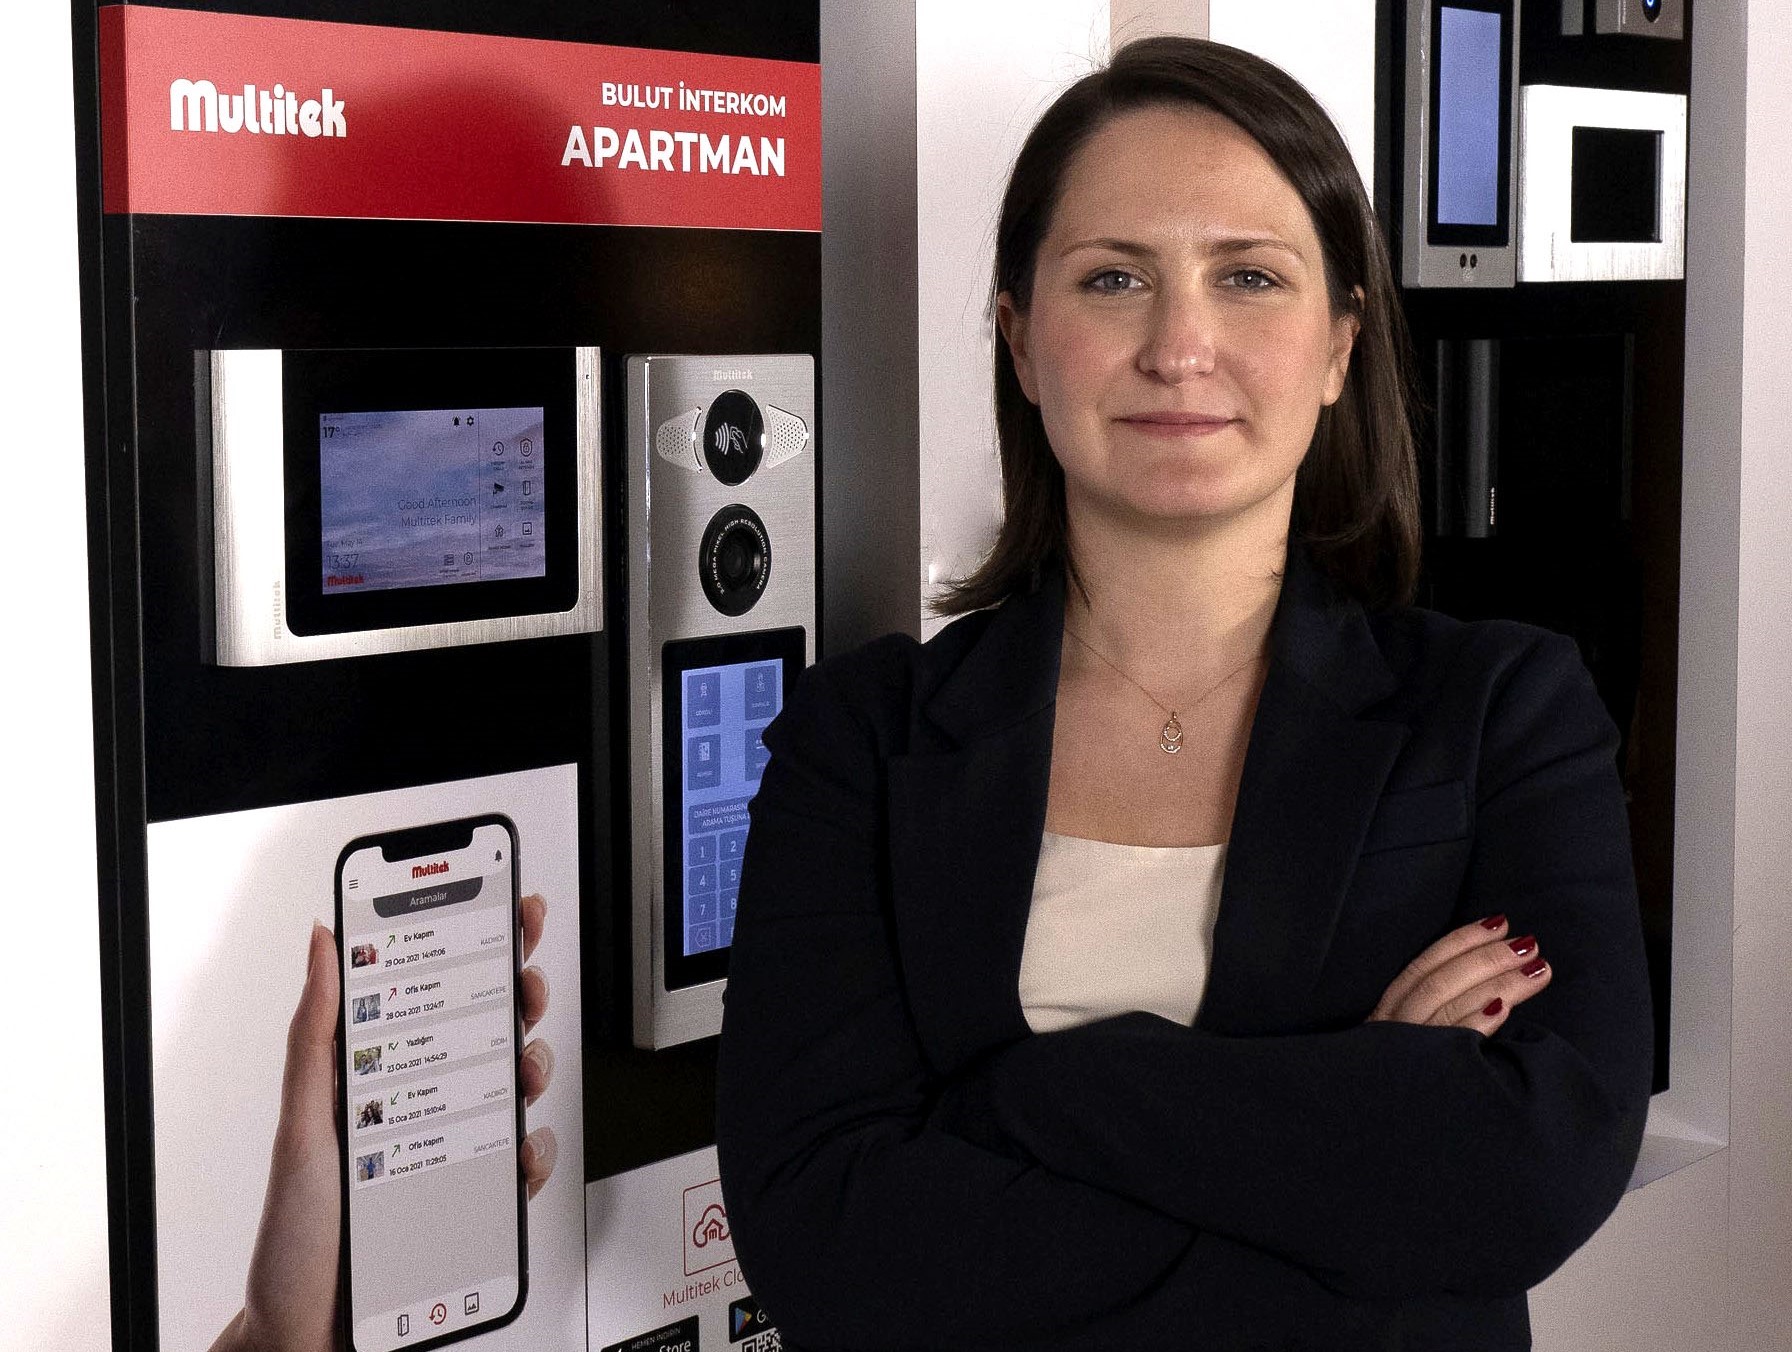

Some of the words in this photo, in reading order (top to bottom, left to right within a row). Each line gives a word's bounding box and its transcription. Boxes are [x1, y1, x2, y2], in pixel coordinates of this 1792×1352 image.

[602, 82, 673, 109] BULUT
[679, 81, 786, 117] İNTERKOM
[170, 78, 347, 138] Multitek
[561, 125, 785, 177] APARTMAN
[398, 498, 425, 511] Good
[427, 496, 477, 509] Afternoon
[401, 516, 442, 527] Multitek
[444, 514, 476, 526] Family
[724, 519, 739, 531] HIGH
[700, 846, 705, 858] 1
[730, 840, 737, 853] 2
[412, 860, 450, 879] Multitek
[730, 869, 737, 881] 5
[699, 874, 706, 887] 4
[409, 892, 447, 907] Aramalar
[730, 898, 738, 910] 8
[700, 903, 706, 916] 7
[404, 934, 412, 943] Ev
[384, 959, 392, 968] 29
[393, 957, 405, 966] Oca
[406, 953, 420, 964] 2021
[405, 985, 419, 996] Ofis
[394, 1010, 407, 1019] Oca
[408, 1005, 421, 1015] 2021
[387, 1064, 395, 1073] 23
[395, 1062, 407, 1071] Oca
[408, 1057, 421, 1068] 2021
[407, 1091, 416, 1099] Ev
[388, 1117, 395, 1125] 15
[395, 1115, 408, 1124] Oca
[408, 1110, 422, 1120] 2021
[408, 1141, 422, 1151] Ofis
[389, 1168, 396, 1176] 16
[396, 1165, 409, 1174] Oca
[410, 1160, 423, 1171] 2021
[662, 1275, 720, 1309] Multitek
[723, 1268, 744, 1287] Clo
